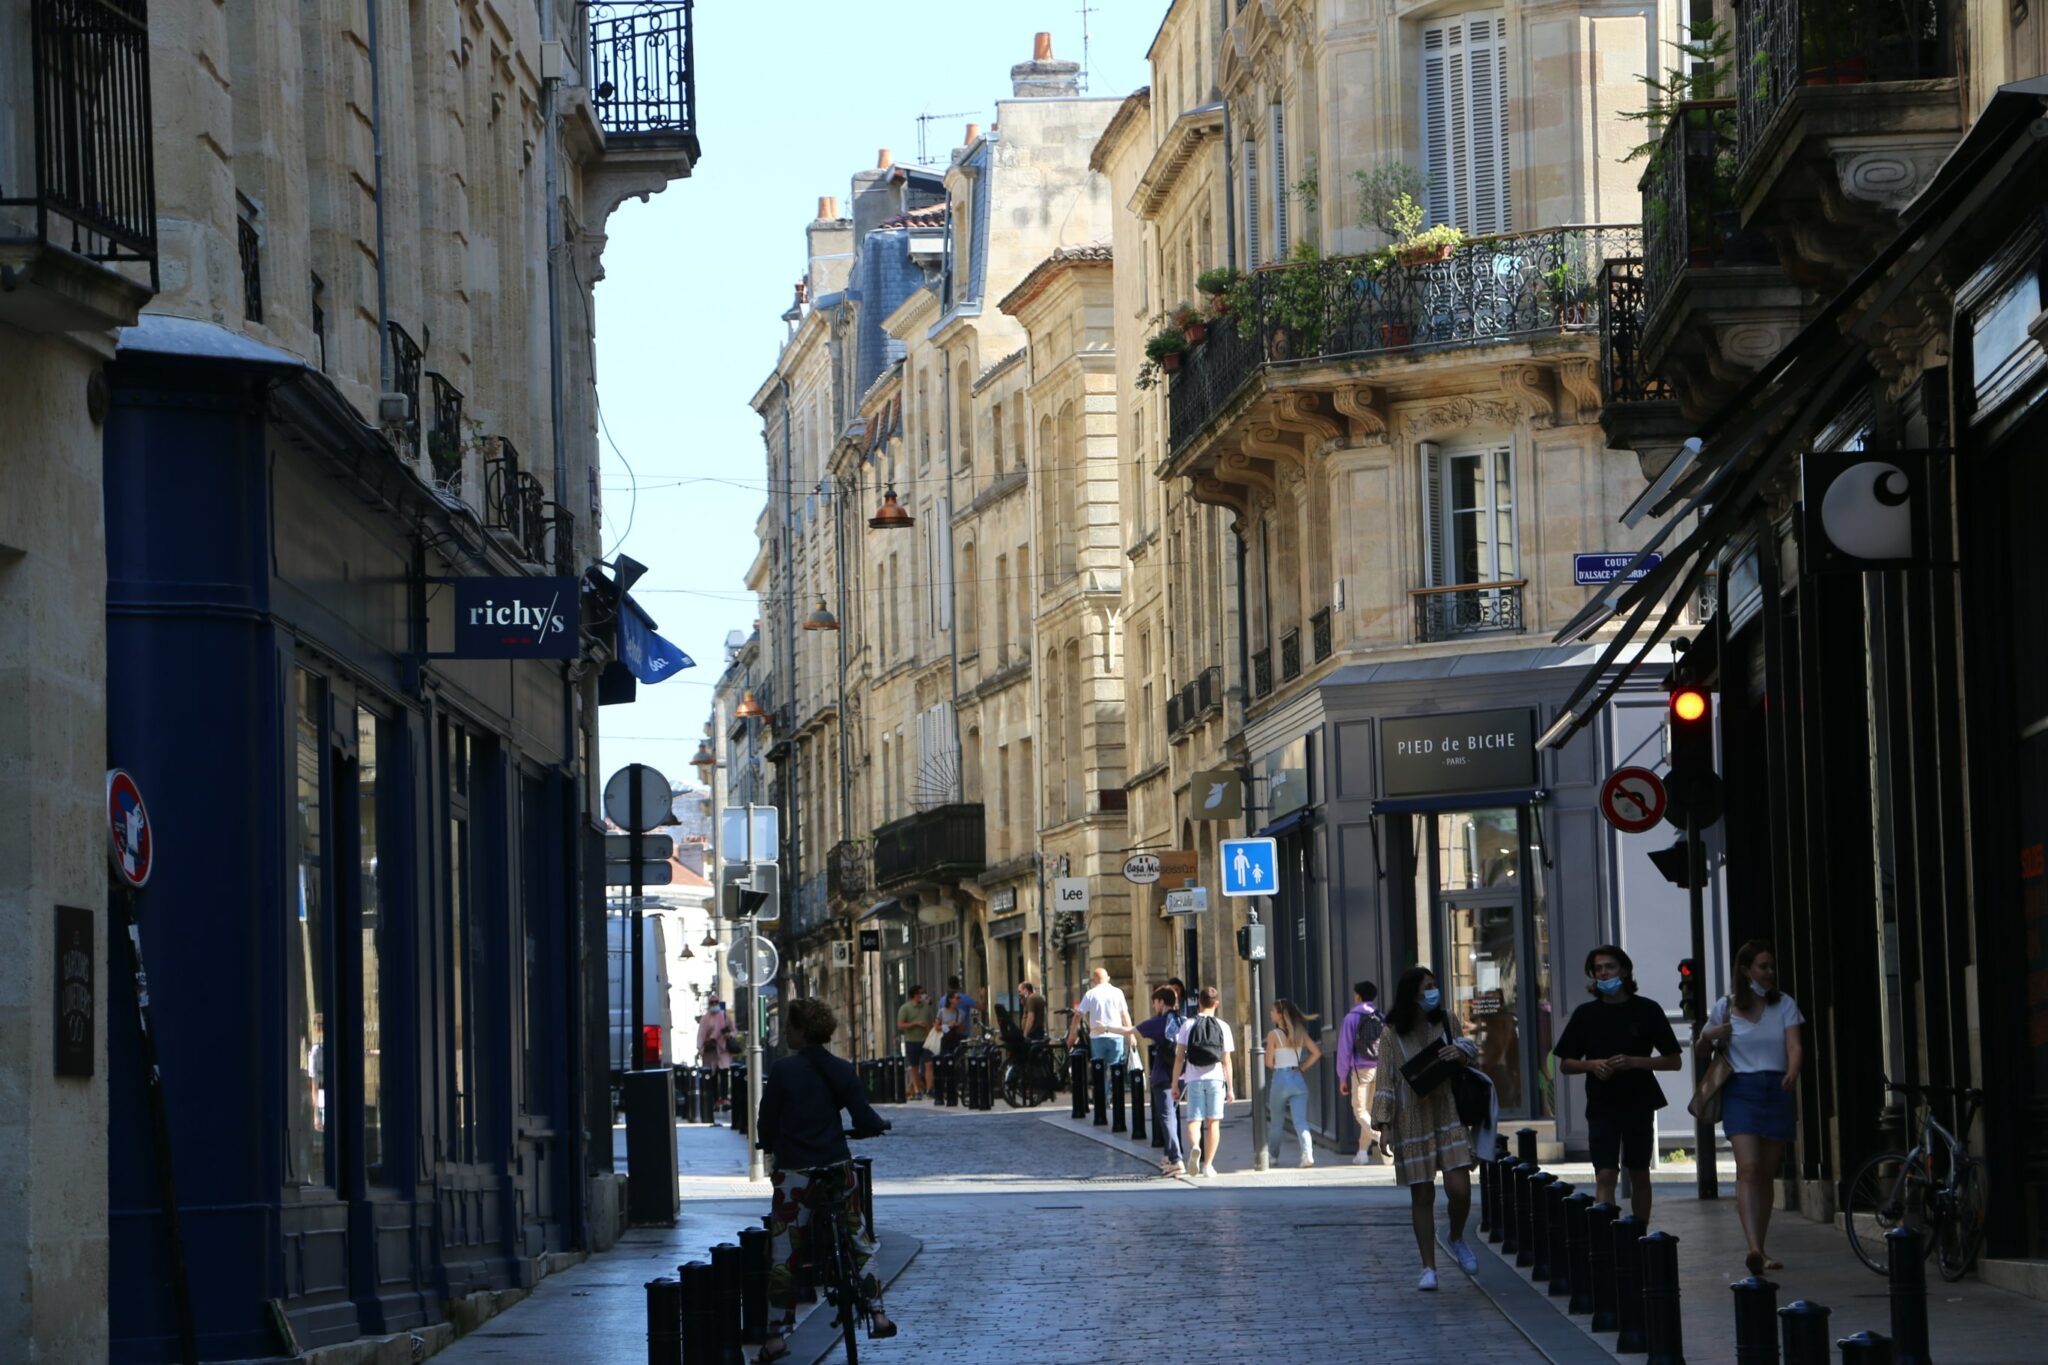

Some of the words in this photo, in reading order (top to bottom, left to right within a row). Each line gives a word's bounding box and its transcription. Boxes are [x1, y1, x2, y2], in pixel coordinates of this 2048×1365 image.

[1397, 740, 1433, 755] PIED
[1441, 737, 1460, 752] de
[1467, 733, 1516, 750] BICHE
[1127, 863, 1144, 873] Casa
[1062, 889, 1083, 901] Lee
